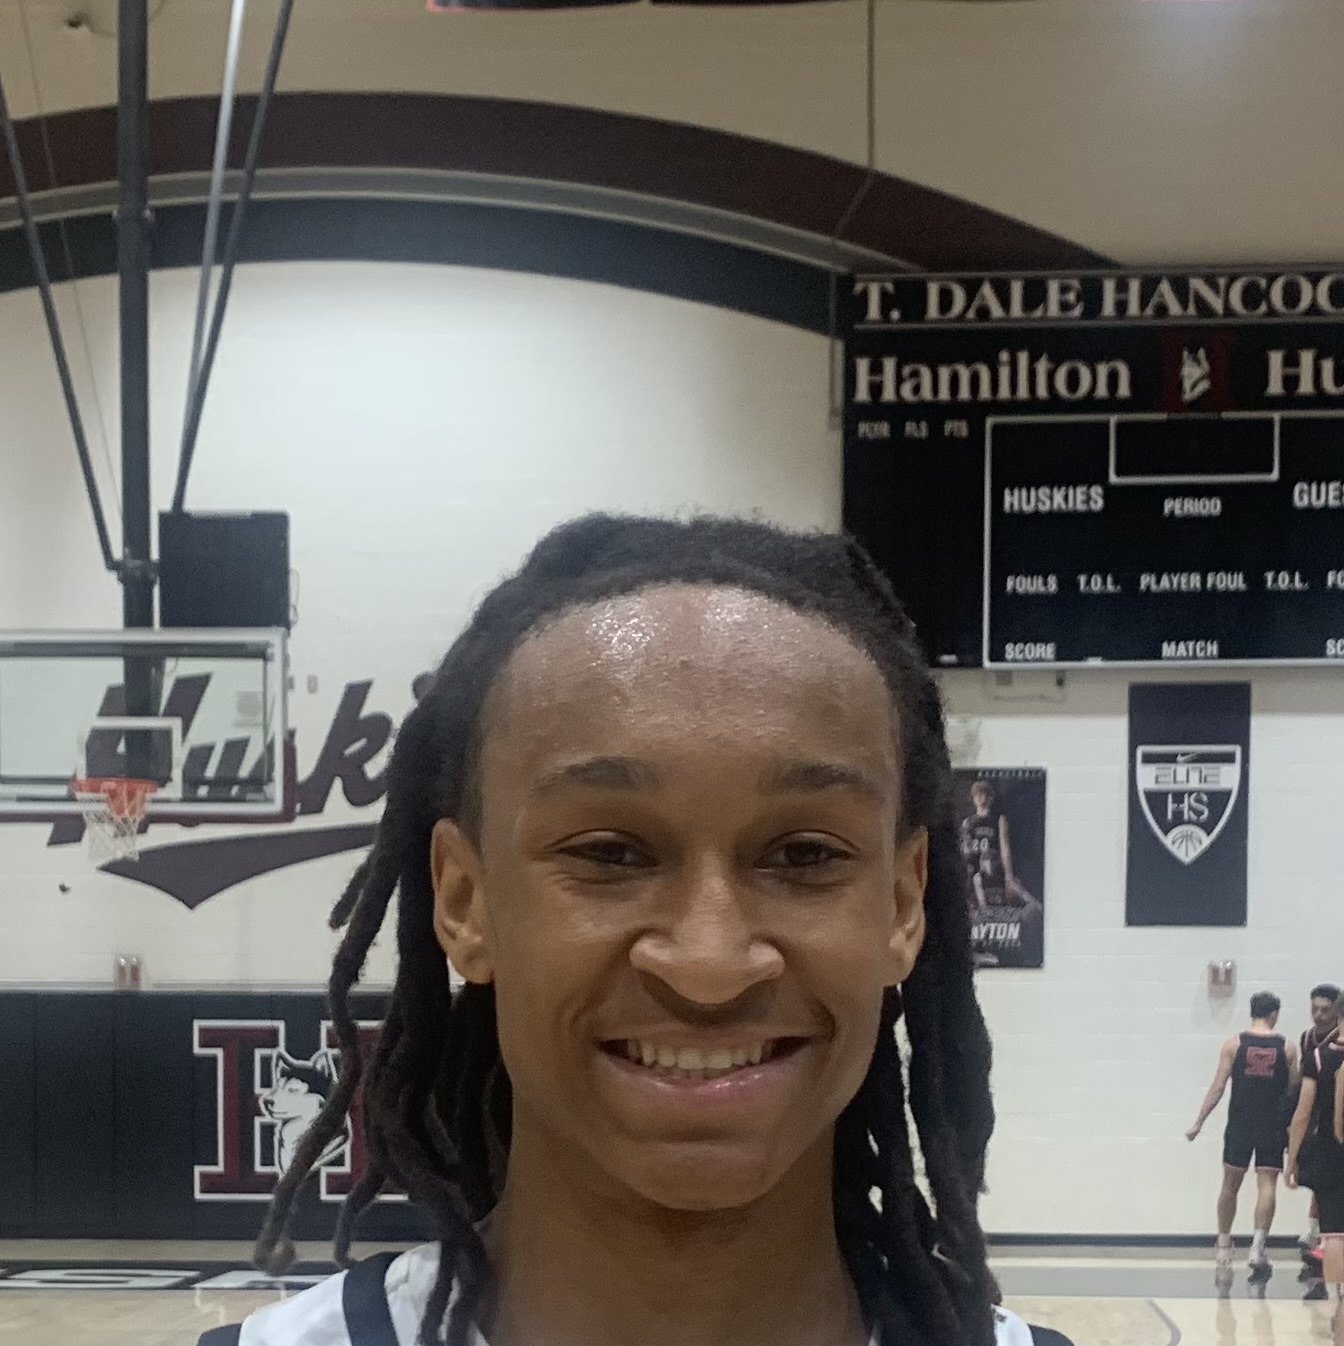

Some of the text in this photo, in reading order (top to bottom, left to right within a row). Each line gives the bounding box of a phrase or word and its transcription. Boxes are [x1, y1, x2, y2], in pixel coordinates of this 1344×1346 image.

[853, 281, 901, 324] T.
[924, 277, 1085, 321] DALE
[853, 347, 1132, 402] Hamilton
[1003, 484, 1105, 515] HUSKIES
[1163, 496, 1222, 518] PERIOD
[1006, 573, 1058, 596] FOULS
[1077, 573, 1122, 594] T.O.L.
[1139, 572, 1202, 593] PLAYER
[1206, 570, 1247, 592] FOUL
[1005, 641, 1056, 662] SCORE
[1161, 639, 1219, 660] MATCH
[1154, 765, 1222, 786] ELITE
[1166, 791, 1210, 823] HS
